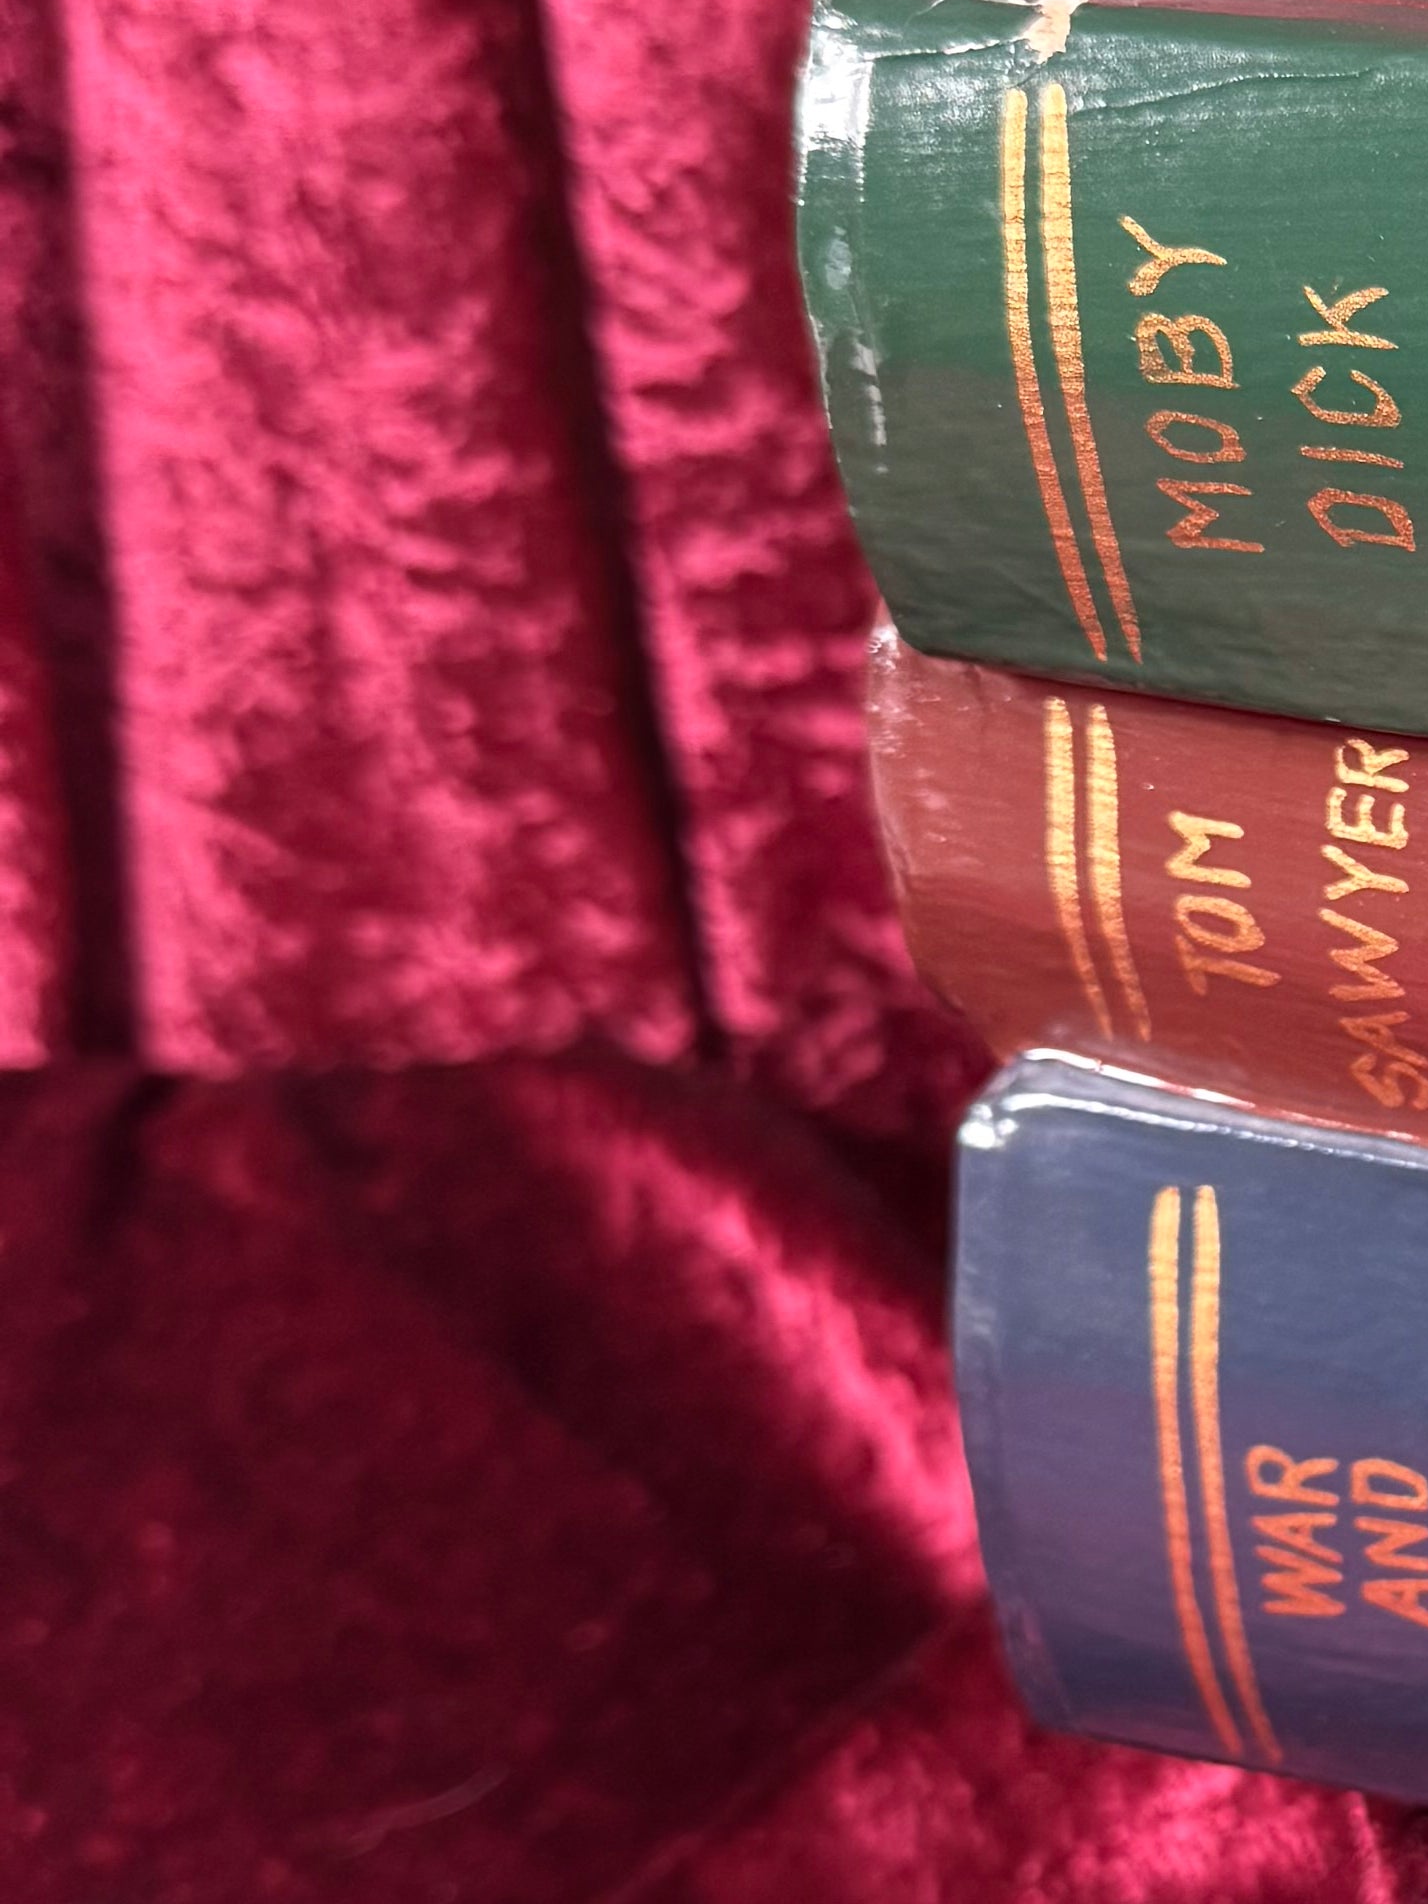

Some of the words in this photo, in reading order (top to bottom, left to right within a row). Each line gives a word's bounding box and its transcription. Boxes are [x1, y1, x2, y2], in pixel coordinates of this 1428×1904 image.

[1120, 214, 1265, 553] MOBY
[1292, 285, 1417, 552] DICK
[1167, 811, 1279, 992] TOM
[1246, 1444, 1346, 1616] WAR
